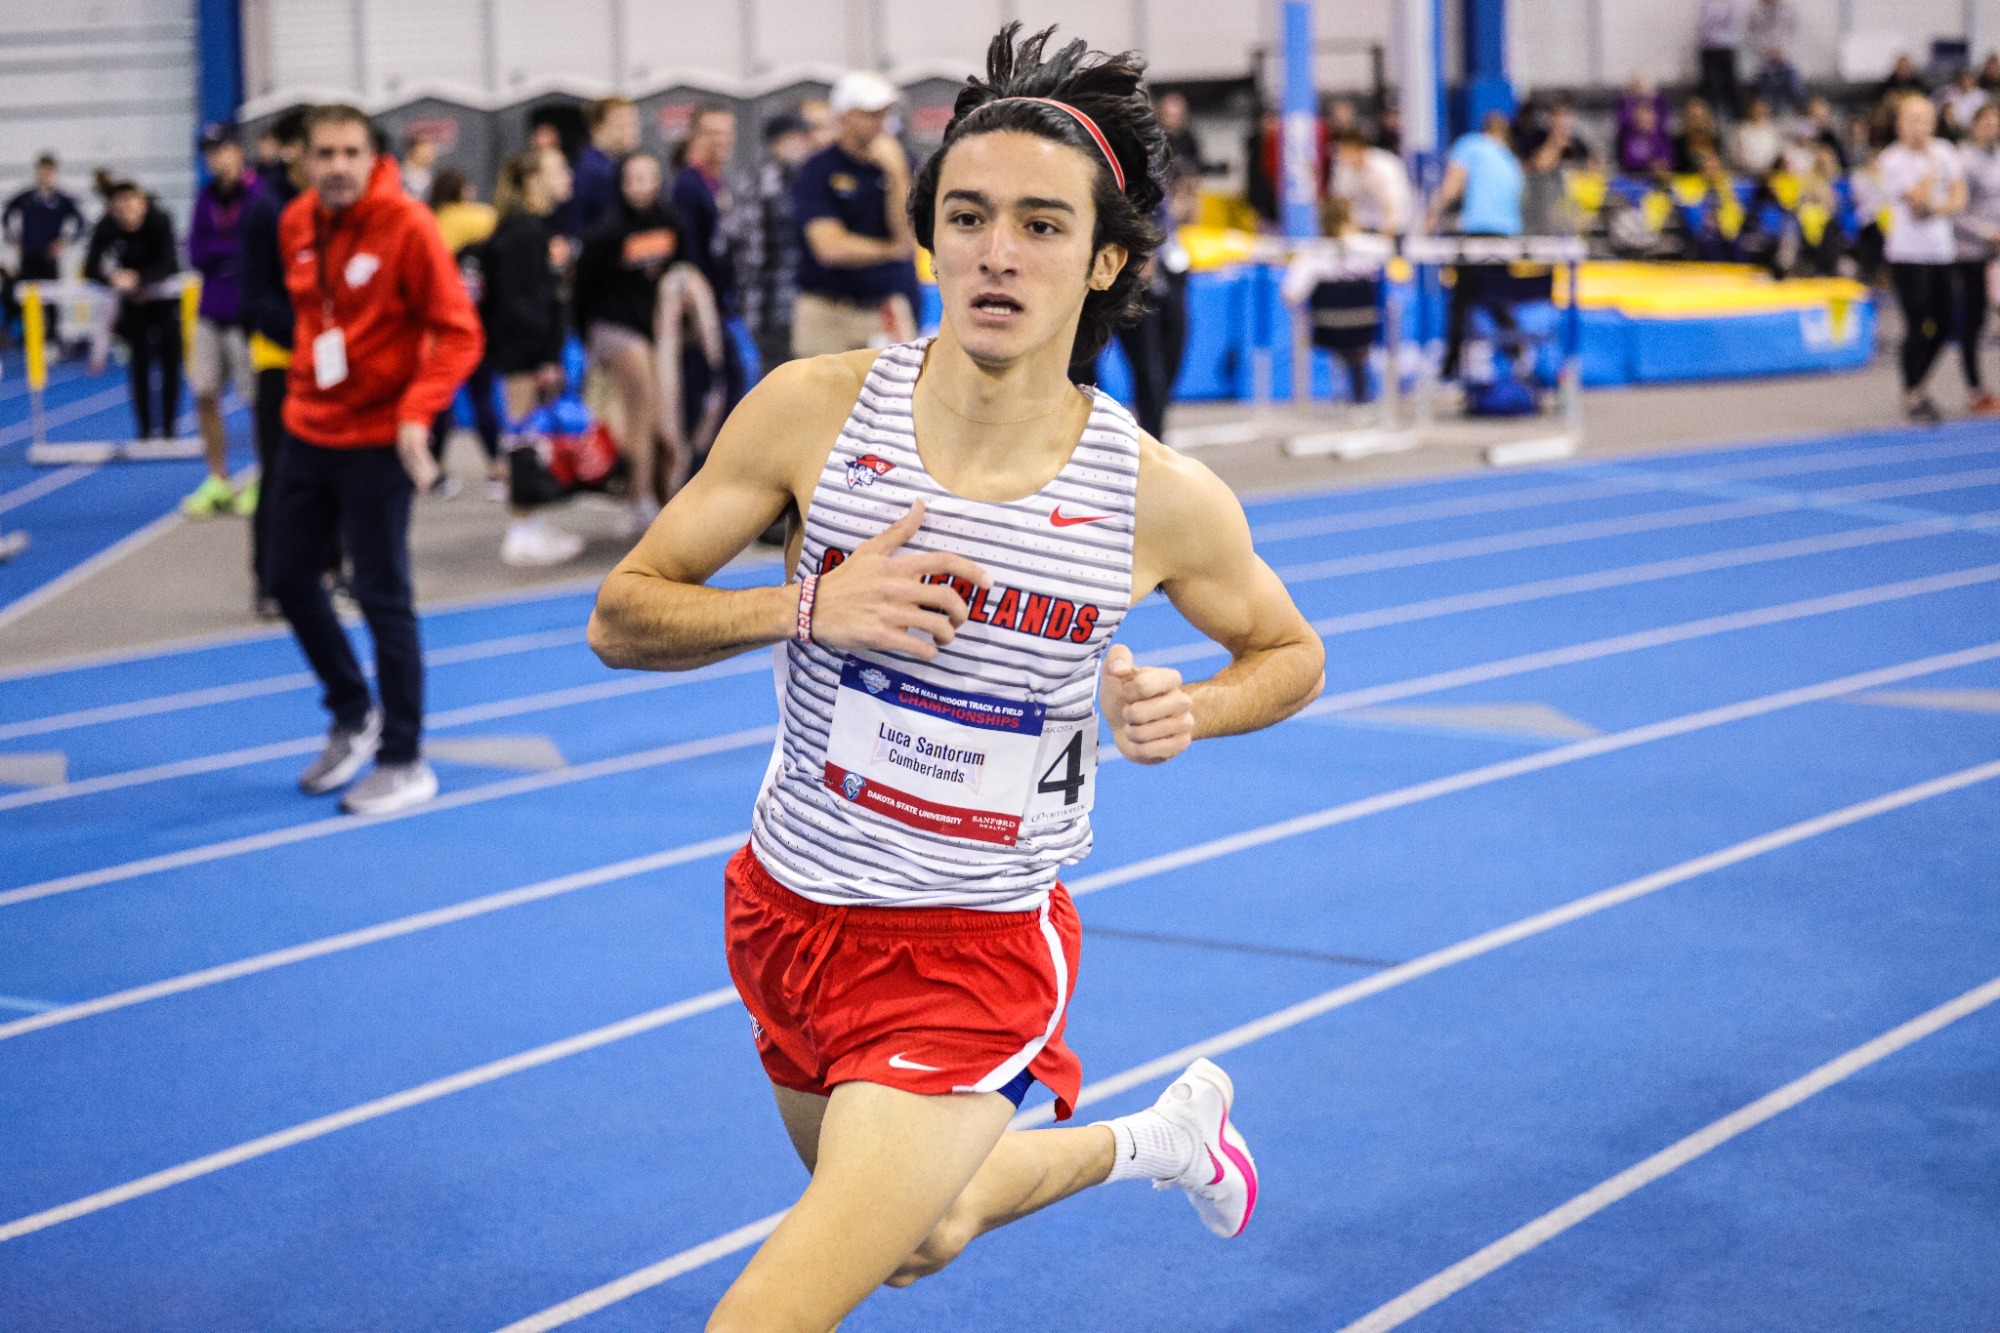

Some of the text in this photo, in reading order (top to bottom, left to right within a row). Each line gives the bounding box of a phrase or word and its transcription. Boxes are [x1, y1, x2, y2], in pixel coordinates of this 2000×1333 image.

[898, 692, 1020, 729] CHAMPIONSHIPS
[900, 682, 920, 694] 2024
[920, 689, 938, 701] NAIA
[939, 695, 969, 708] INDOOR
[969, 701, 993, 712] TRACK
[1002, 706, 1024, 717] FIELD
[879, 722, 985, 766] Luca Santorum
[1042, 724, 1074, 734] AKOTA
[888, 748, 965, 783] Cumberlands
[1037, 729, 1085, 806] 4
[867, 790, 963, 825] DAKOTA STATE UNIVERSITY
[971, 815, 1016, 829] SANFORD
[979, 824, 1006, 832] HEALTH
